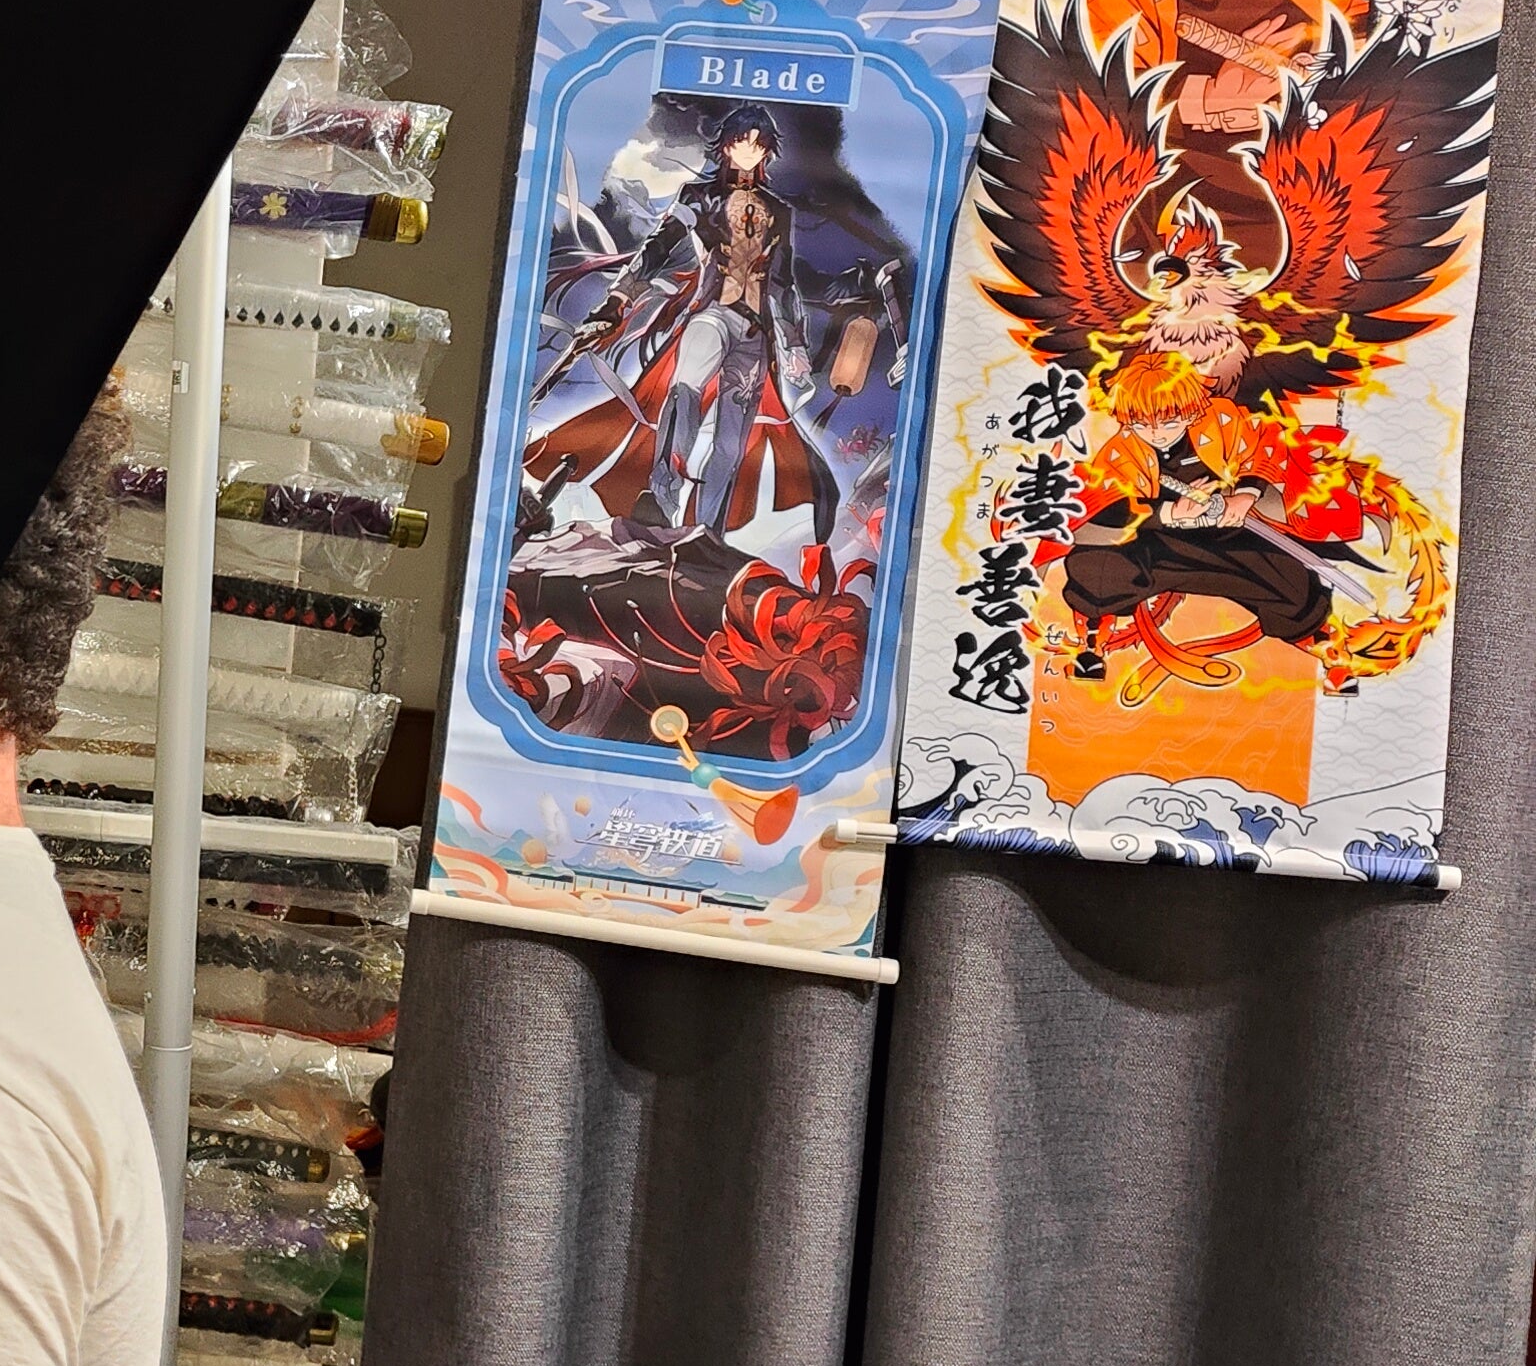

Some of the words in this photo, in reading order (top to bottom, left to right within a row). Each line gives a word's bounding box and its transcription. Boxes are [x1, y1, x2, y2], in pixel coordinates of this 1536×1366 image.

[698, 56, 826, 93] Blade
[976, 413, 1000, 519] あがつま
